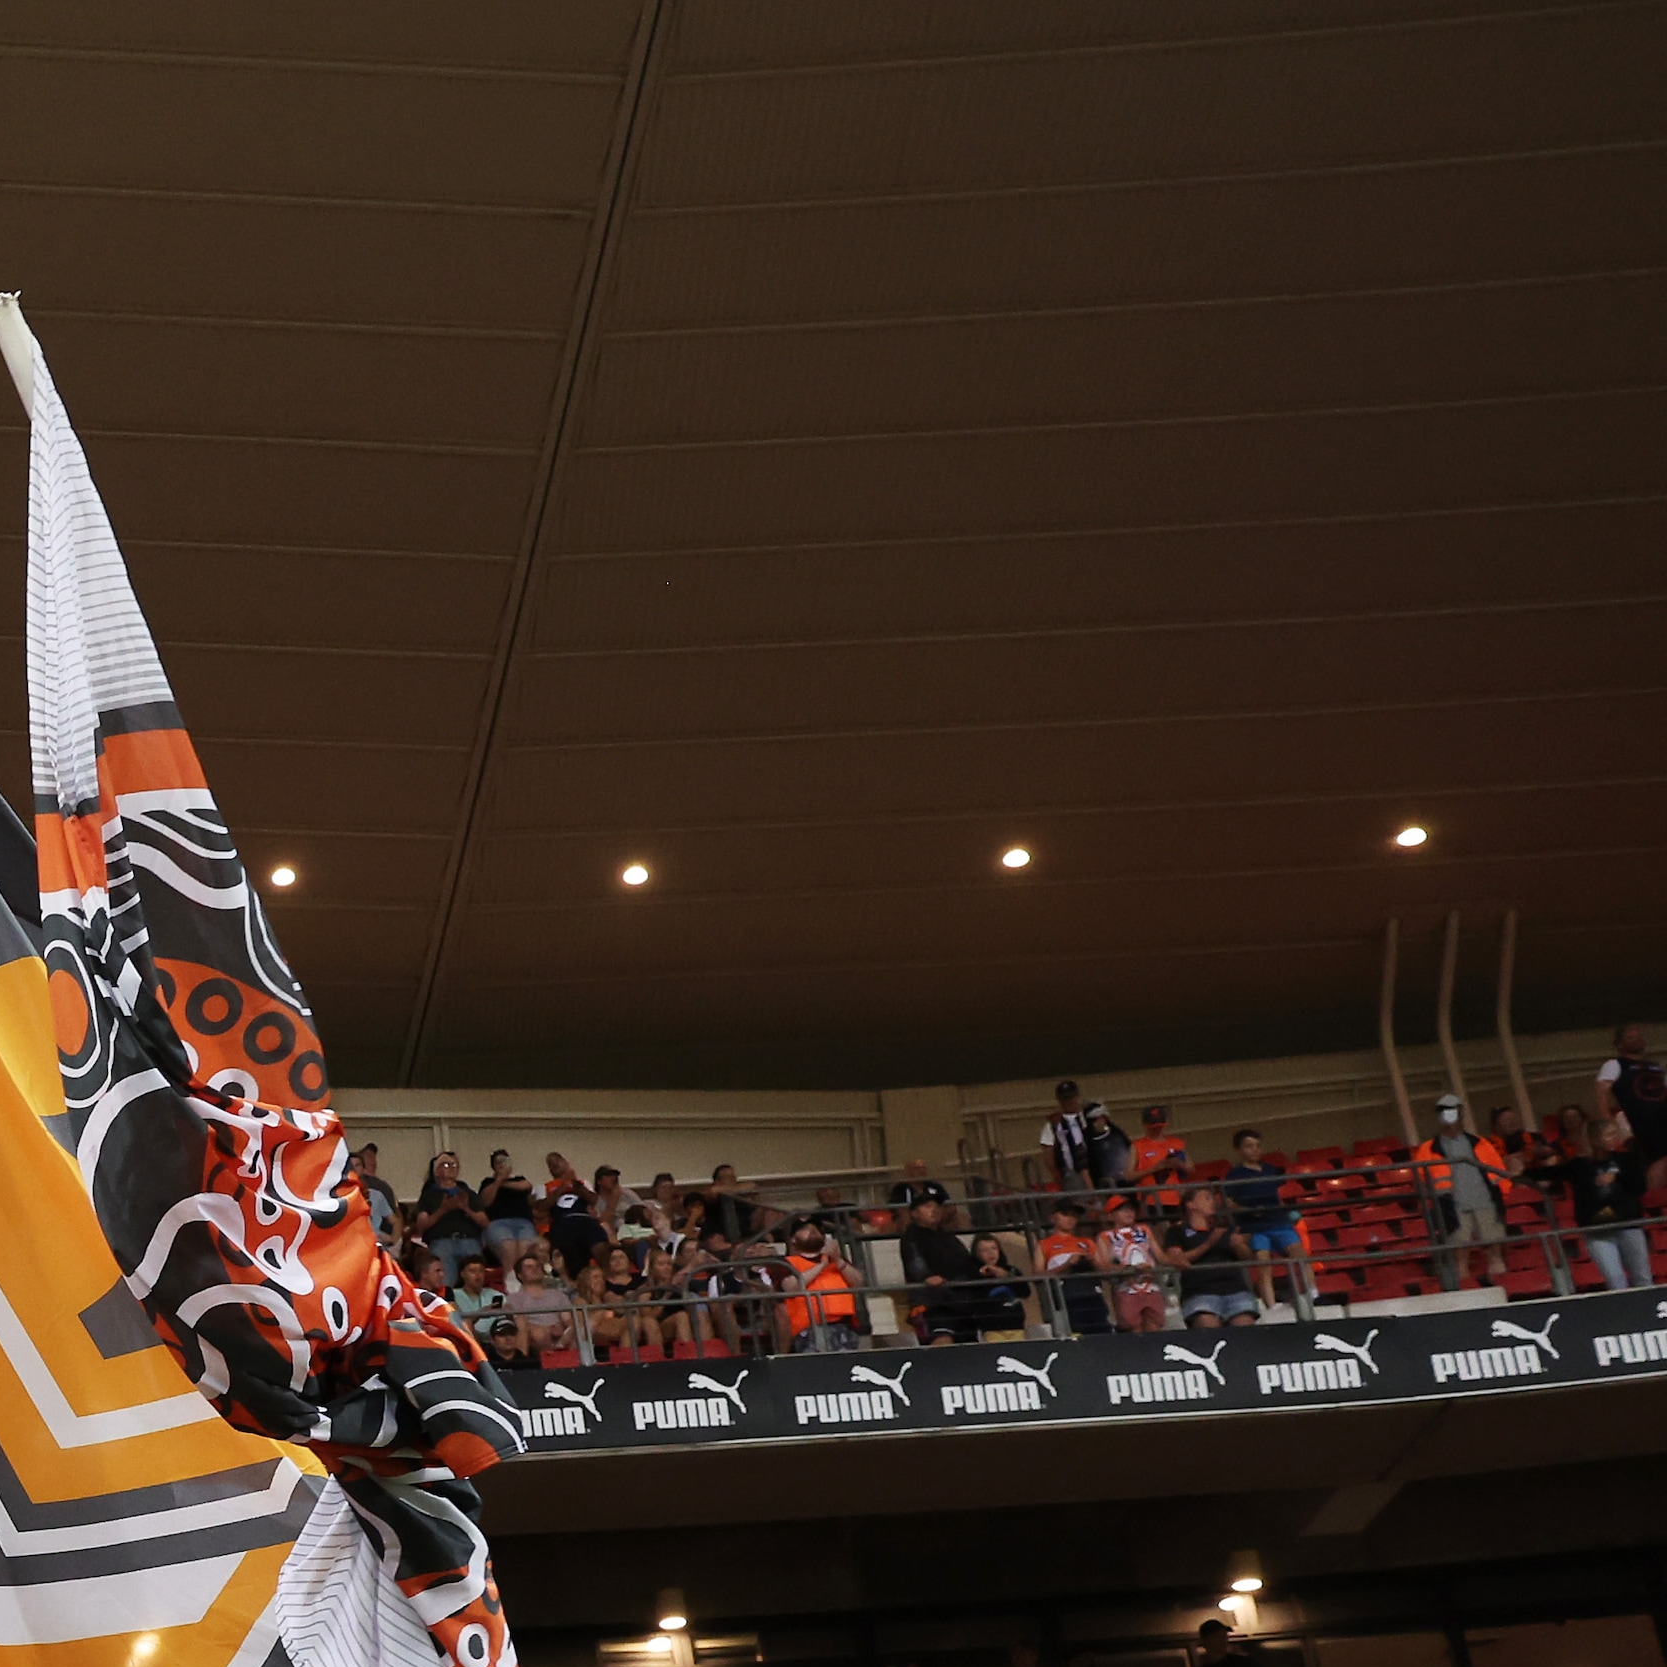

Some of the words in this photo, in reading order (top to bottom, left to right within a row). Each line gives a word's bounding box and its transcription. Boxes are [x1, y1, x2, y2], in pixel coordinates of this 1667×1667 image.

[1430, 1344, 1543, 1383] PUMA
[1593, 1329, 1667, 1367] PUM
[1106, 1370, 1209, 1405] PUMA
[1257, 1358, 1363, 1394] PUMA
[632, 1398, 731, 1431] PUMA
[794, 1390, 895, 1425] PUMA
[941, 1381, 1041, 1416] PUMA
